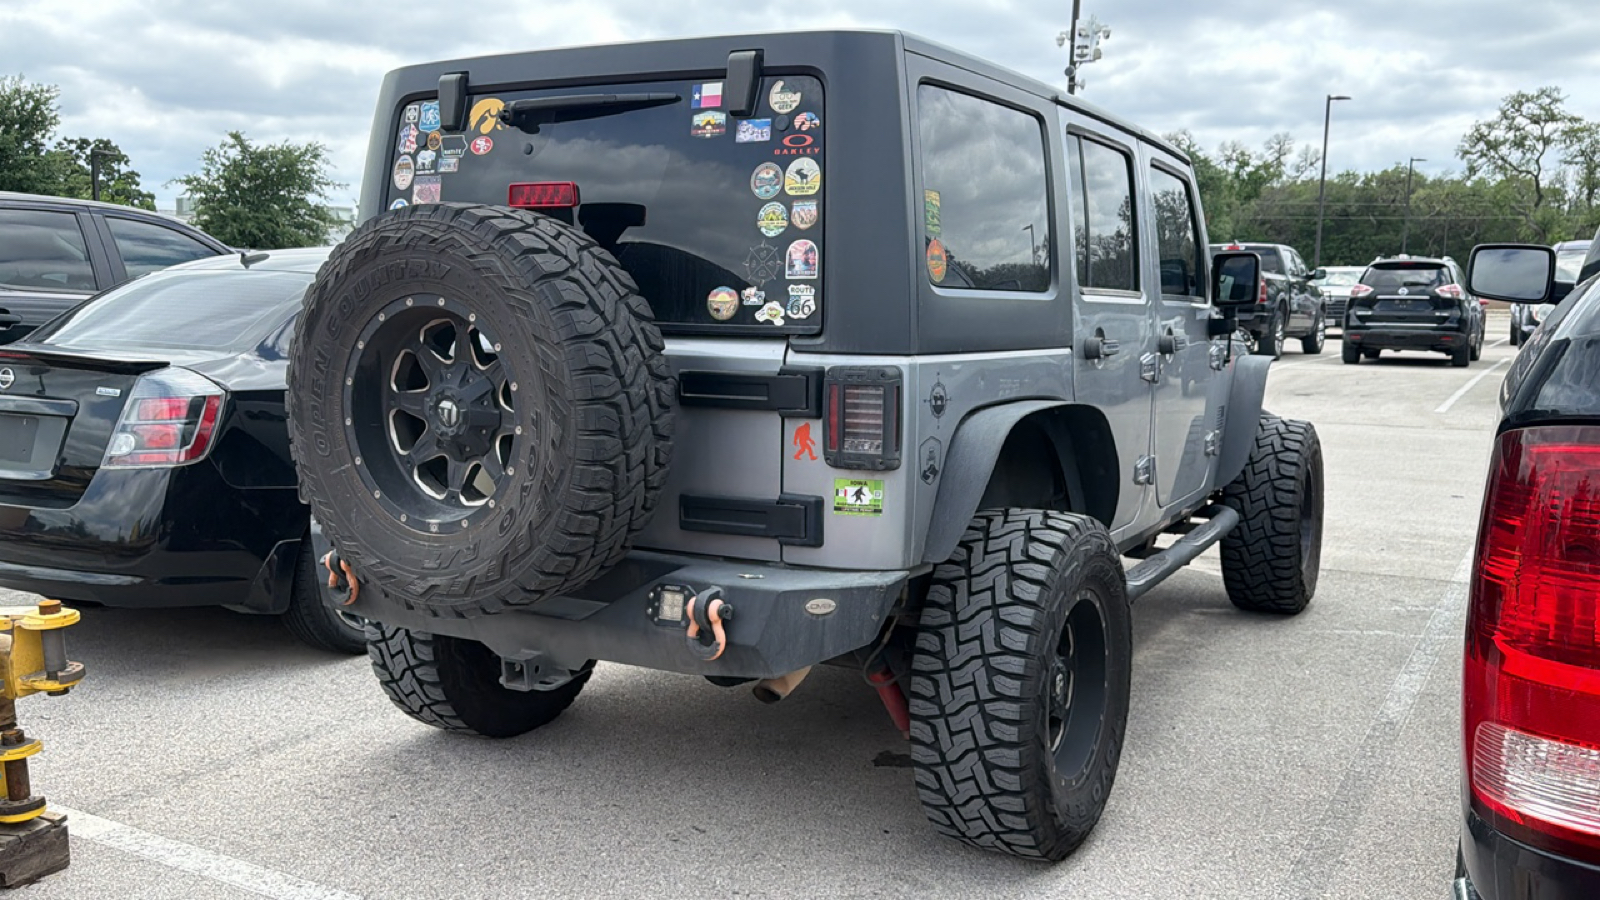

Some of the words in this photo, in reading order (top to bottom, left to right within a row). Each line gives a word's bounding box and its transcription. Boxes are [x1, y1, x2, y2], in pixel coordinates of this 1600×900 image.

[311, 349, 332, 457] OPEN
[327, 259, 450, 341] COUNTRY
[790, 299, 811, 316] 66
